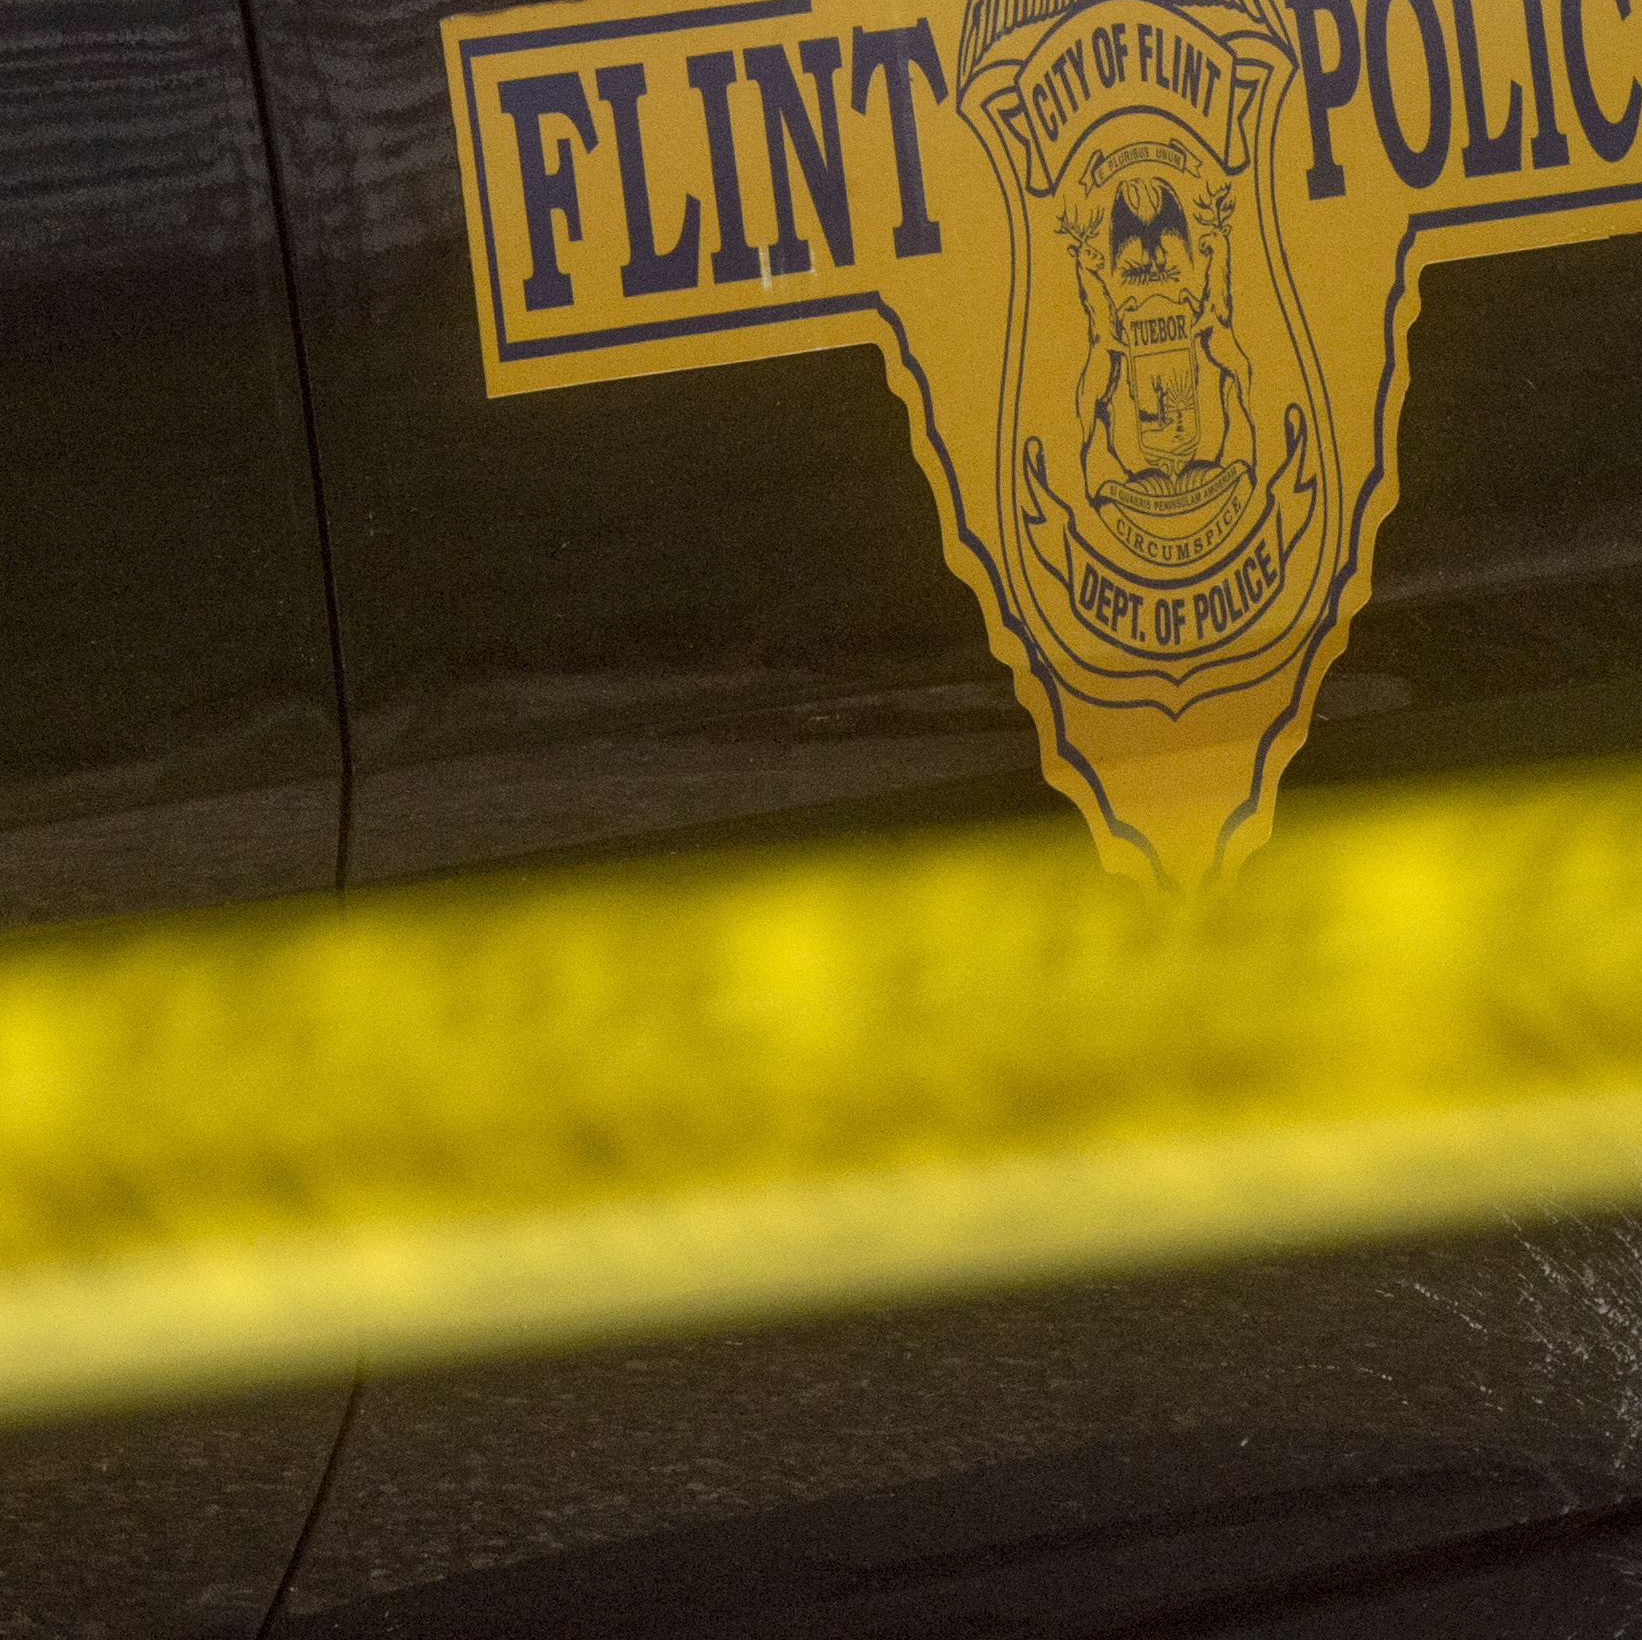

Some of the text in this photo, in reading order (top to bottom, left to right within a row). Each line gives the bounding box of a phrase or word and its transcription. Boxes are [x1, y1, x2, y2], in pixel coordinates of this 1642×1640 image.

[1032, 22, 1222, 142] CITY OF FLINT
[497, 17, 949, 312] FLINT
[1108, 146, 1150, 171] PLURIBUS
[1155, 146, 1182, 166] UNUM
[1130, 314, 1189, 347] TUEBOR
[1116, 495, 1241, 561] CIRCUMSPICE
[1079, 539, 1279, 646] DEPT. OF POLICE
